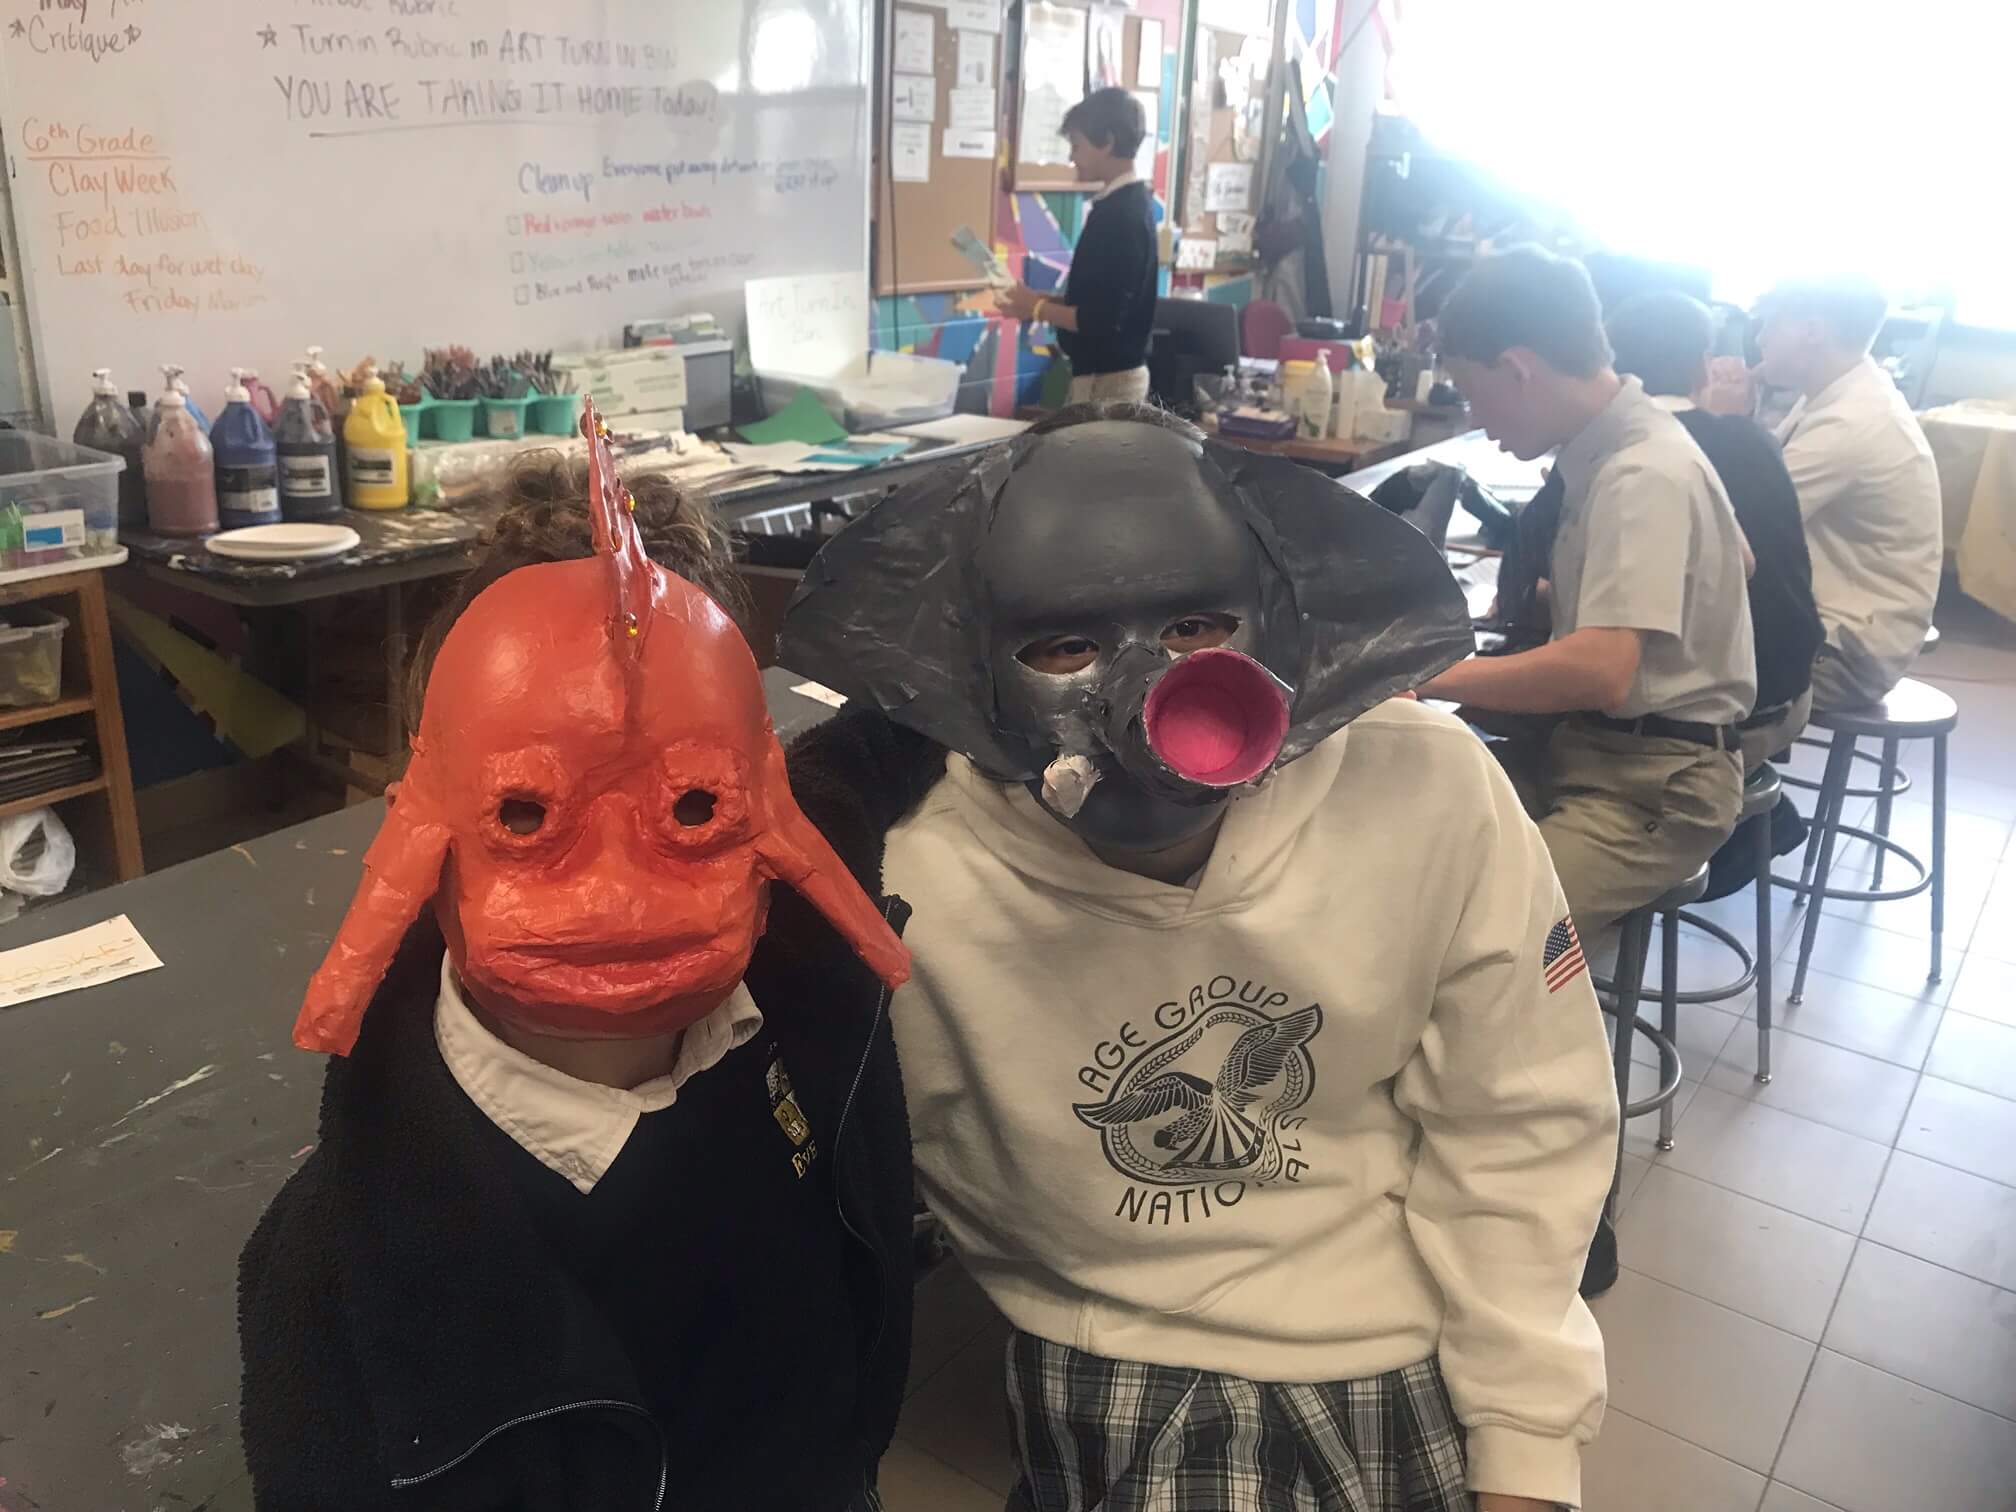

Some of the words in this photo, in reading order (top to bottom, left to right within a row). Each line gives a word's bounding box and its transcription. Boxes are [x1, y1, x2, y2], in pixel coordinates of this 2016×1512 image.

[499, 29, 545, 65] ART
[554, 35, 611, 66] TURN
[616, 41, 636, 68] IN
[274, 75, 332, 120] YOU
[343, 80, 401, 120] ARE
[533, 81, 567, 115] IT
[577, 83, 644, 117] HOME
[22, 117, 69, 153] 6th
[76, 124, 155, 154] Grade
[48, 161, 108, 211] Clay
[116, 165, 177, 195] Week
[55, 206, 126, 248] Food
[129, 207, 208, 238] Illusion
[56, 253, 104, 276] Last
[114, 254, 152, 287] day
[157, 252, 185, 276] for
[191, 252, 224, 277] wet
[123, 287, 199, 317] Friday
[1078, 1021, 1147, 1094] AGE
[1154, 975, 1289, 1031] GROUP
